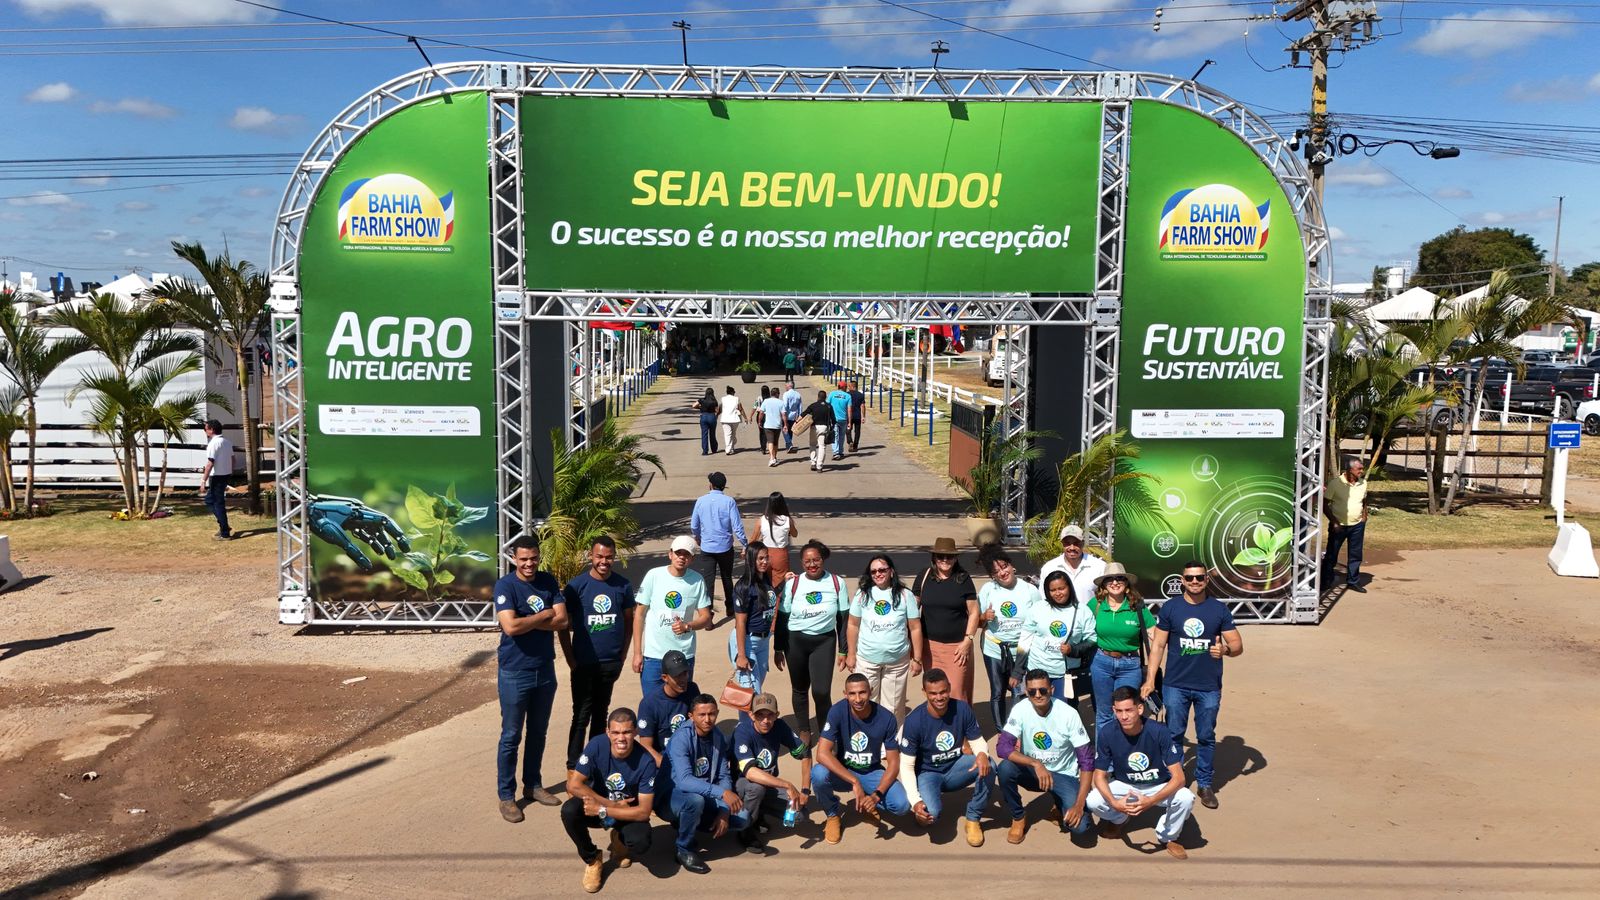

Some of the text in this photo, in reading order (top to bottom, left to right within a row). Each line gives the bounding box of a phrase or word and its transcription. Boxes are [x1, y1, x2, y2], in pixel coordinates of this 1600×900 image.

[631, 169, 1002, 208] SEJA BEM-VINDO!
[368, 193, 422, 214] BAHIA
[1190, 203, 1241, 223] BAHIA
[351, 216, 440, 237] FARM SHOW
[1172, 226, 1257, 246] FARM SHOW
[551, 220, 1071, 256] O sucesso é a nossa melhor recepção!
[326, 311, 473, 358] AGRO
[1143, 323, 1286, 356] FUTURO
[328, 358, 473, 381] INTELIGENTE
[1142, 357, 1284, 380] SUSTENTÁVEL
[587, 614, 617, 625] FAET
[1180, 637, 1211, 649] FAET
[844, 751, 873, 765] FAET
[931, 747, 961, 762] FAET
[1126, 768, 1159, 781] FAET
